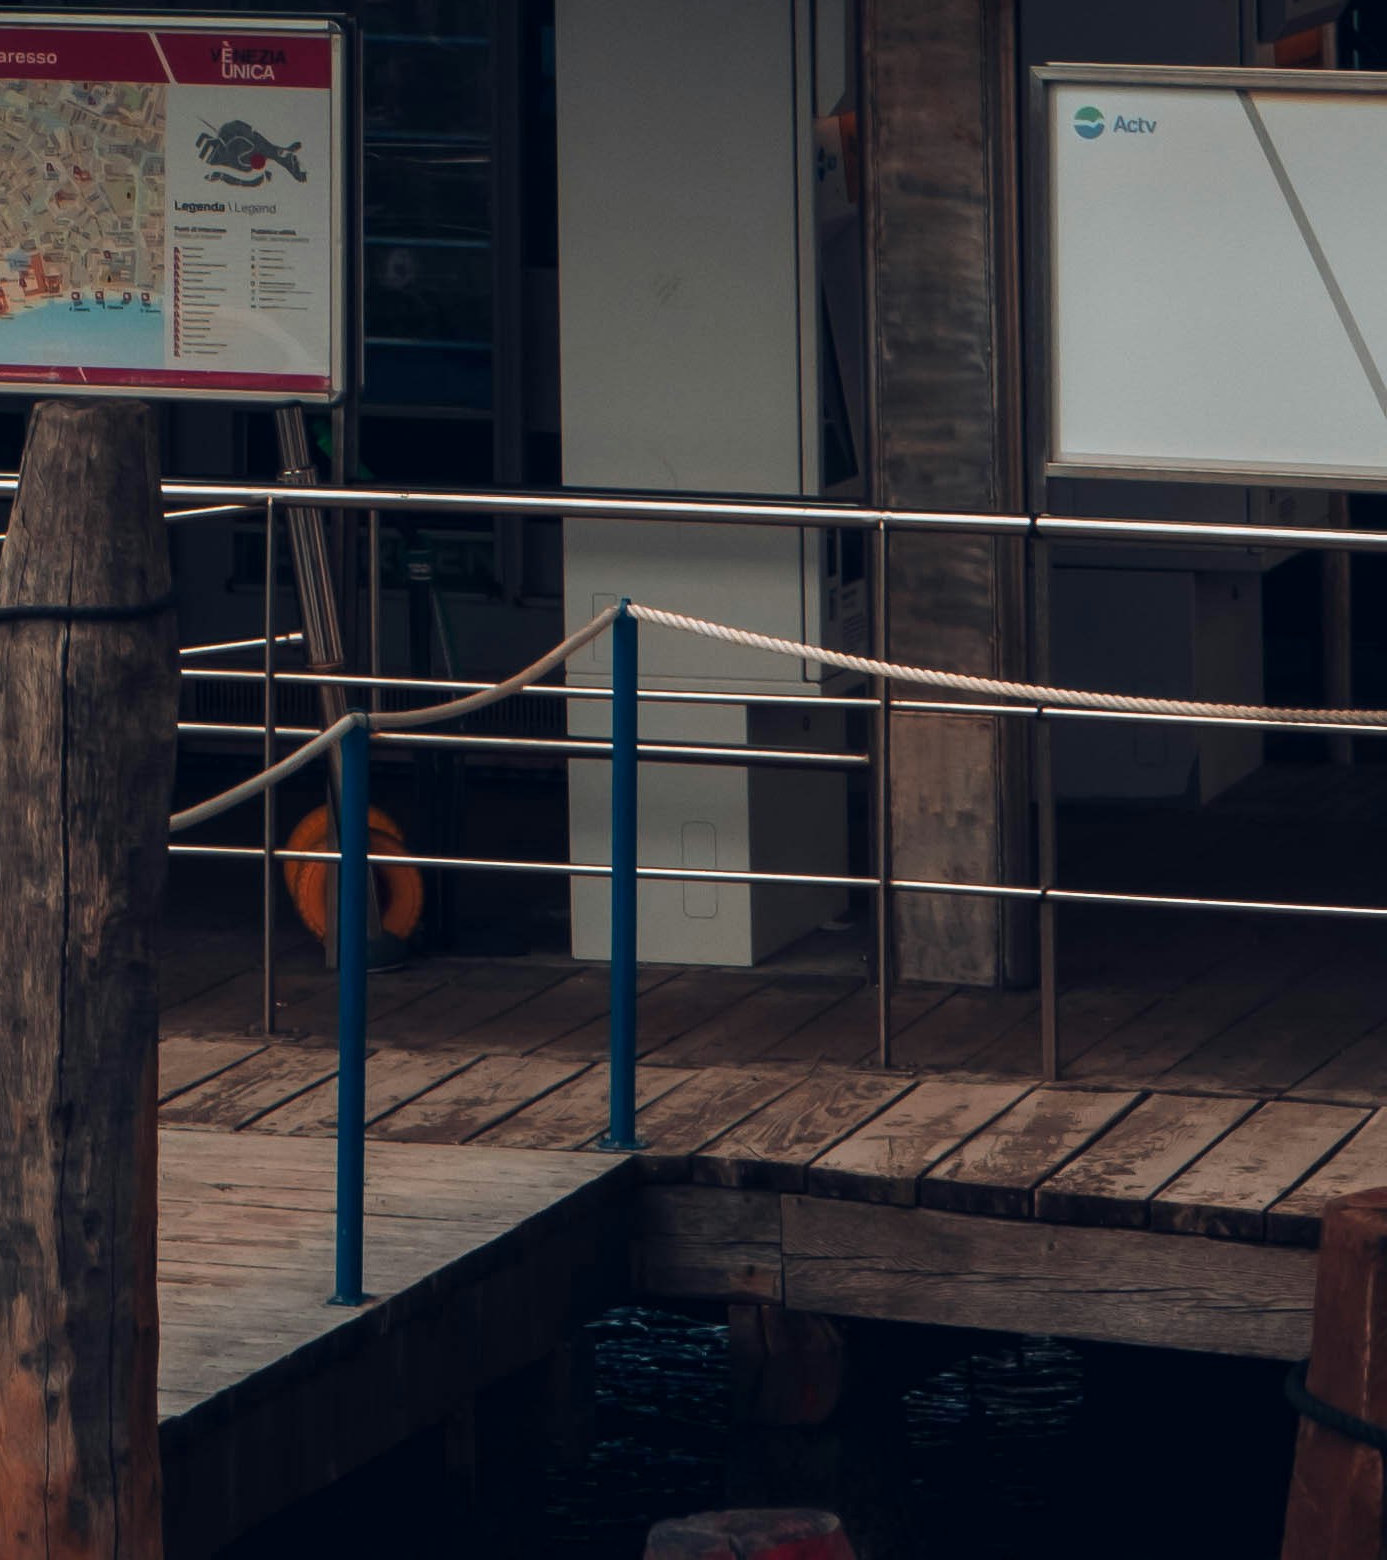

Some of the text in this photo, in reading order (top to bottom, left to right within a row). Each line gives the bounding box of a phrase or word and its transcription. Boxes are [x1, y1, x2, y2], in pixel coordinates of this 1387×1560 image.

[221, 64, 276, 81] UNICA
[1113, 115, 1158, 134] Actv
[174, 200, 225, 213] Legenda
[234, 202, 277, 216] Legend
